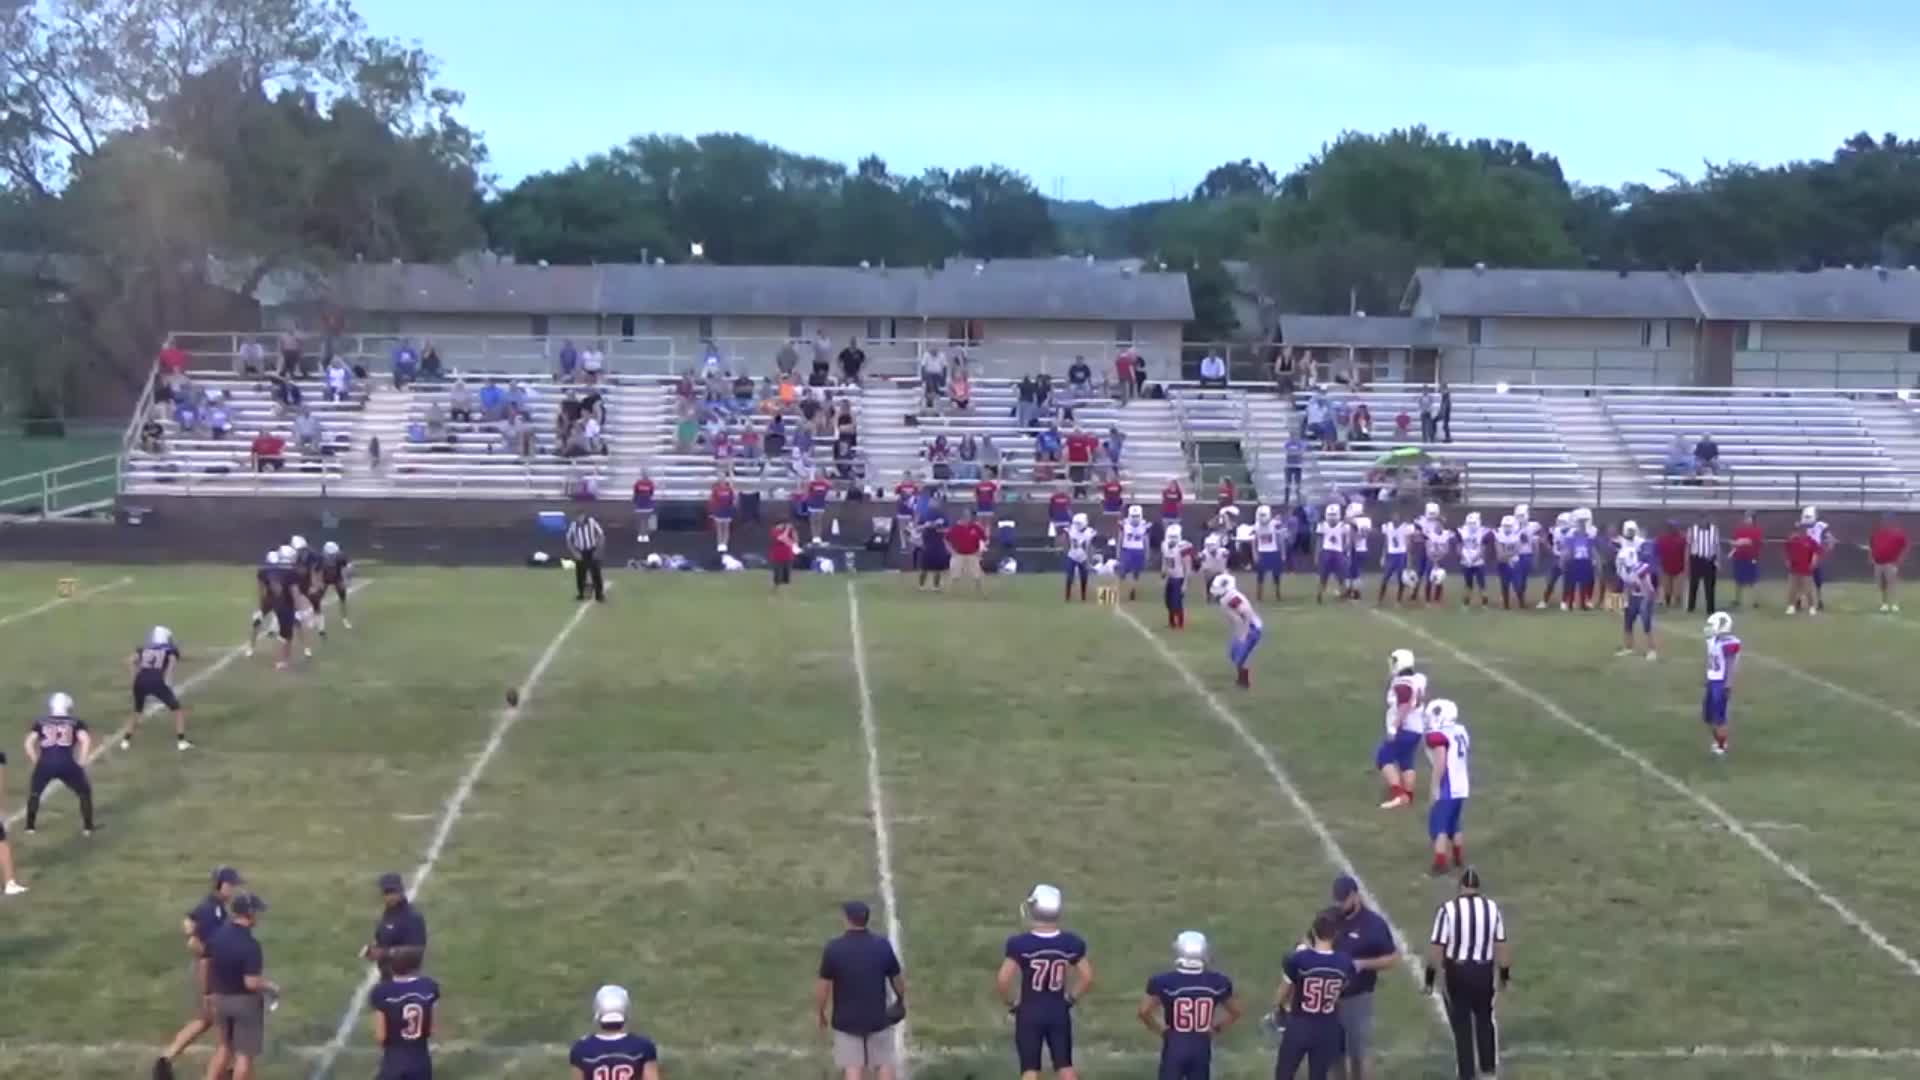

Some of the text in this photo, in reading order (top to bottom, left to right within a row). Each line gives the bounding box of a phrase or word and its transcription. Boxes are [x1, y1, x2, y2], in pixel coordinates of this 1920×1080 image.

[1030, 959, 1067, 992] 70
[1301, 977, 1343, 1014] 55
[401, 1003, 423, 1039] 3
[1174, 997, 1213, 1033] 60
